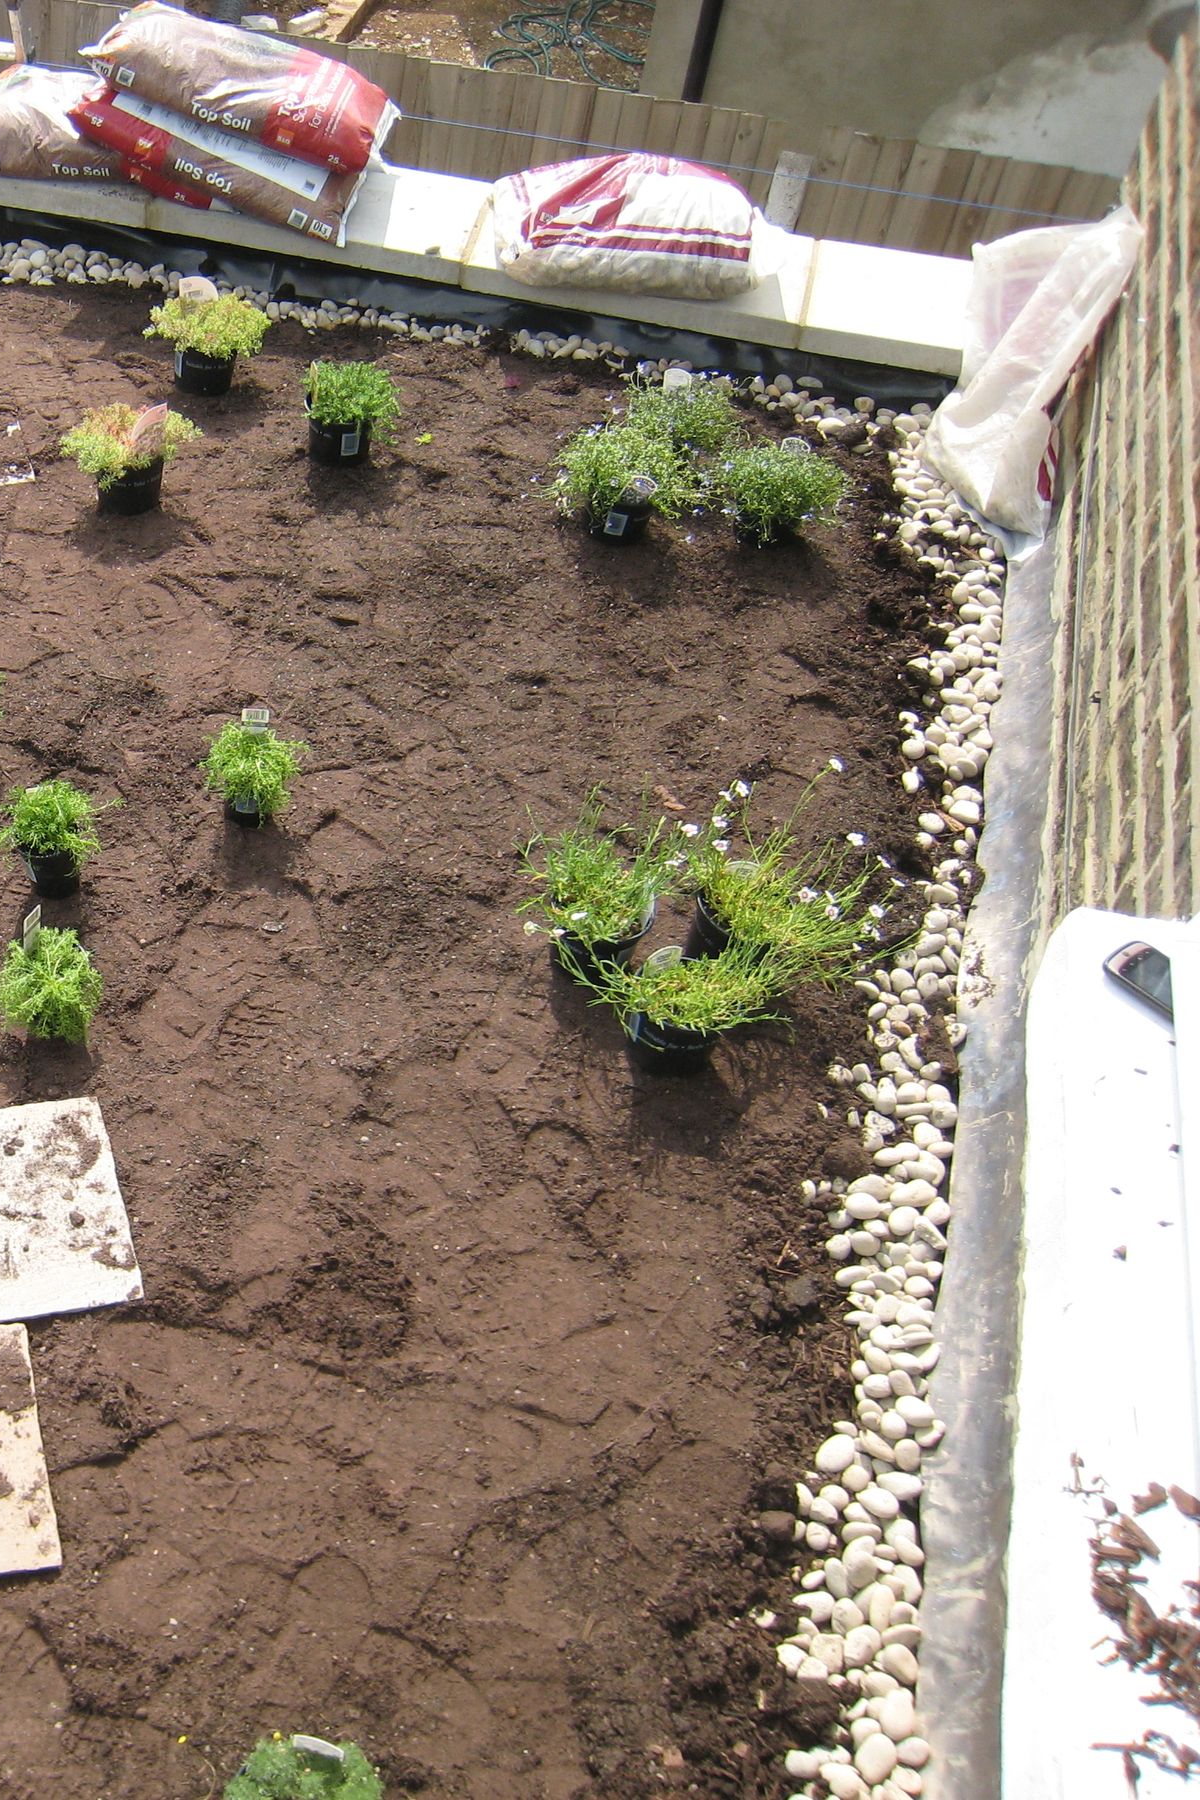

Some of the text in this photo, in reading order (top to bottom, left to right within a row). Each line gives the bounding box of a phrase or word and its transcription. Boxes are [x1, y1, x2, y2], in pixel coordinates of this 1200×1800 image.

[191, 101, 217, 122] Top
[221, 112, 251, 132] Soil
[52, 163, 110, 177] Top Soil
[327, 154, 340, 164] 25
[174, 158, 232, 194] Top Soil
